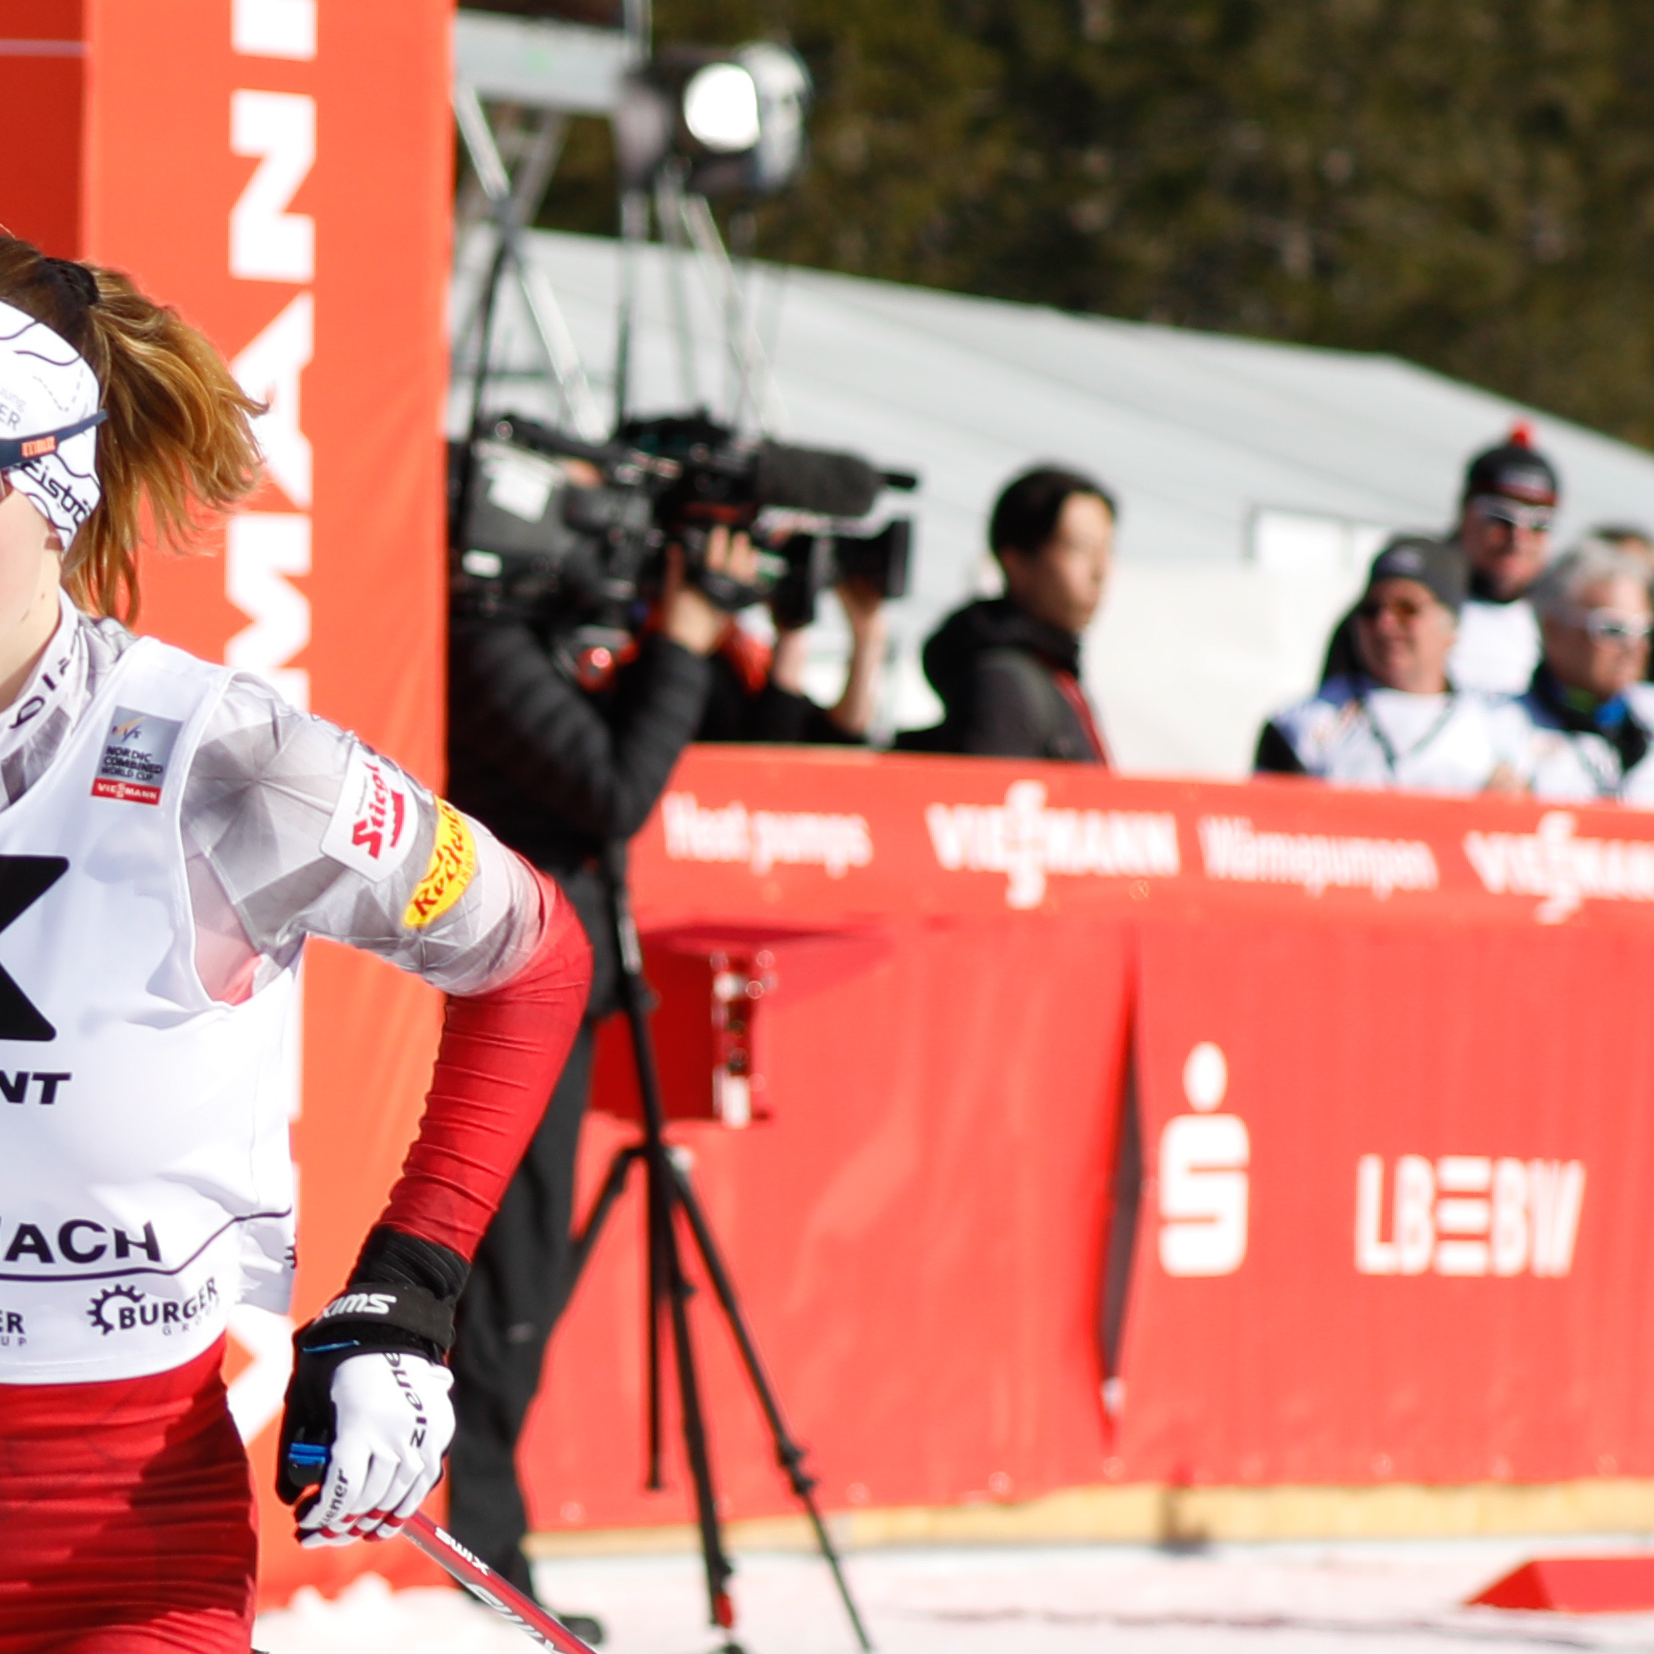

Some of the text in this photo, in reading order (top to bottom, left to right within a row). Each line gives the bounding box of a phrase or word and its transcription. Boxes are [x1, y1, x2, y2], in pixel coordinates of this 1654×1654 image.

[106, 745, 152, 762] NORDIC
[101, 766, 134, 778] WORLD
[104, 755, 163, 774] COMBINED
[97, 782, 158, 799] VIESSMANN
[662, 791, 873, 878] Heat pumps
[118, 1276, 218, 1330] BURGER
